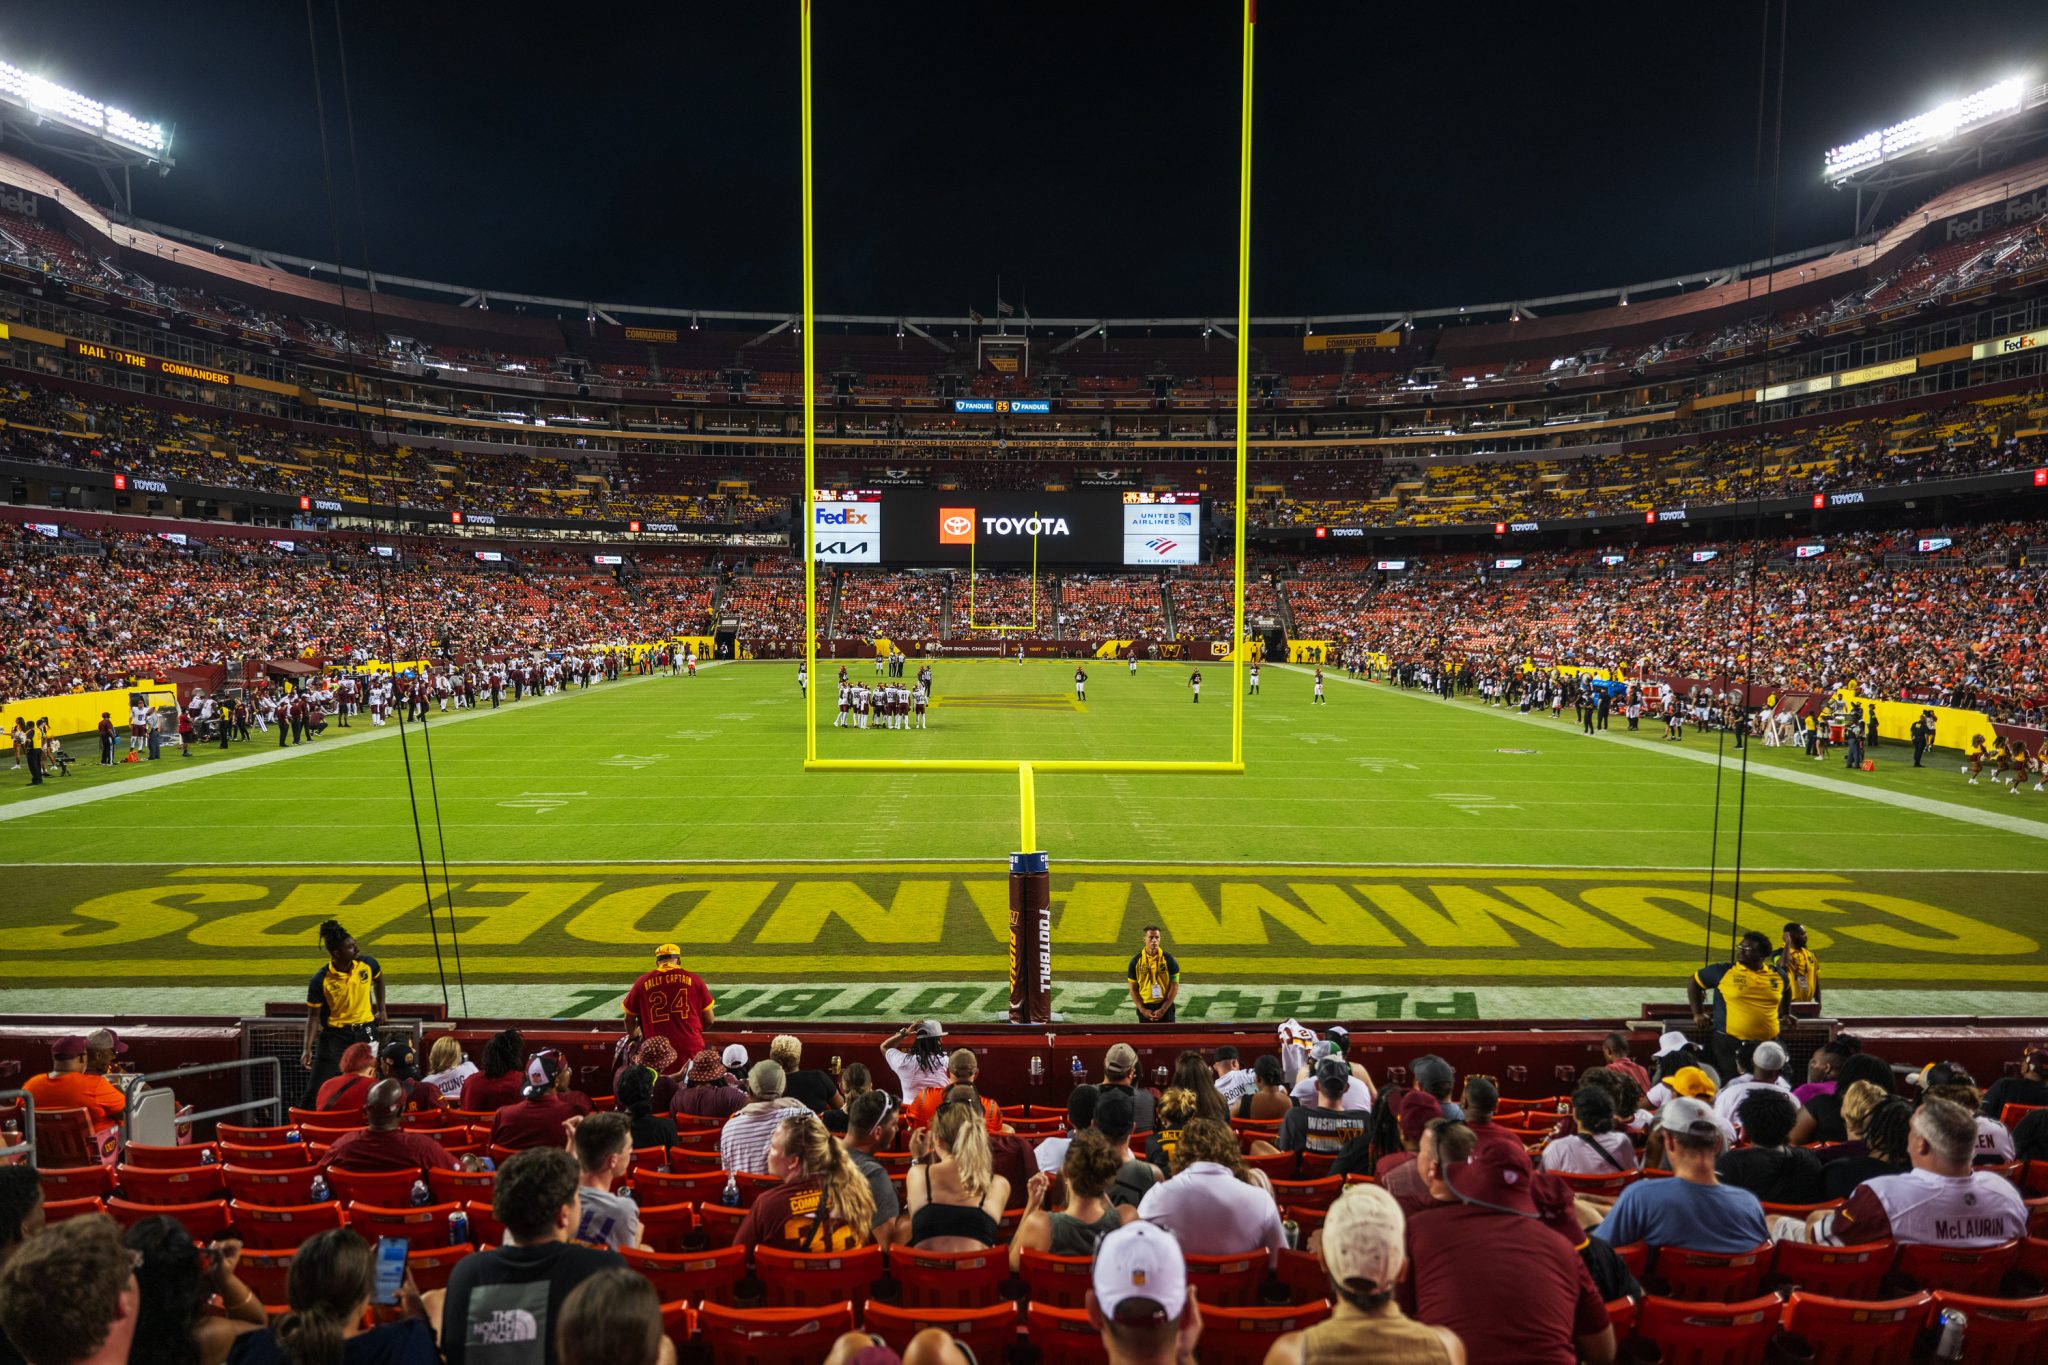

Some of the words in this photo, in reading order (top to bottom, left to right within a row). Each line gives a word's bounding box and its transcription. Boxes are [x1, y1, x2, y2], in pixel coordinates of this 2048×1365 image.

[625, 329, 677, 341] COMMANDERS
[2004, 336, 2035, 352] FedEx
[79, 343, 106, 359] HAIL
[108, 350, 123, 362] TO
[125, 354, 146, 368] THE
[161, 362, 229, 385] COMMANDERS
[997, 402, 1008, 411] 25
[132, 479, 168, 493] TOYOTA
[315, 499, 342, 511] TOYOTA
[1830, 492, 1864, 505] TOYOTA
[466, 514, 496, 524] TOYOTA
[815, 508, 868, 525] FedEx
[1659, 510, 1686, 521] TOYOTA
[646, 523, 678, 532] TOYOTA
[982, 517, 1070, 535] TOYOTA
[1332, 528, 1364, 536] TOYOTA
[1510, 522, 1539, 532] TOYOTA
[815, 541, 868, 554] KIA
[1214, 644, 1227, 654] 25
[0, 882, 2042, 956] COMMANDERS
[644, 975, 663, 991] RALLY
[665, 974, 692, 986] CAPTAIN
[648, 988, 690, 1024] 24
[1182, 988, 1480, 1020] PLAY
[1223, 1083, 1246, 1102] RROW
[1307, 1116, 1364, 1131] WASHINGTON
[1162, 1131, 1180, 1140] McL
[790, 1196, 820, 1212] COMM
[1935, 1217, 2004, 1240] McLAURIN
[492, 1310, 516, 1321] THE
[474, 1320, 515, 1335] NORTH
[483, 1332, 515, 1344] FACE
